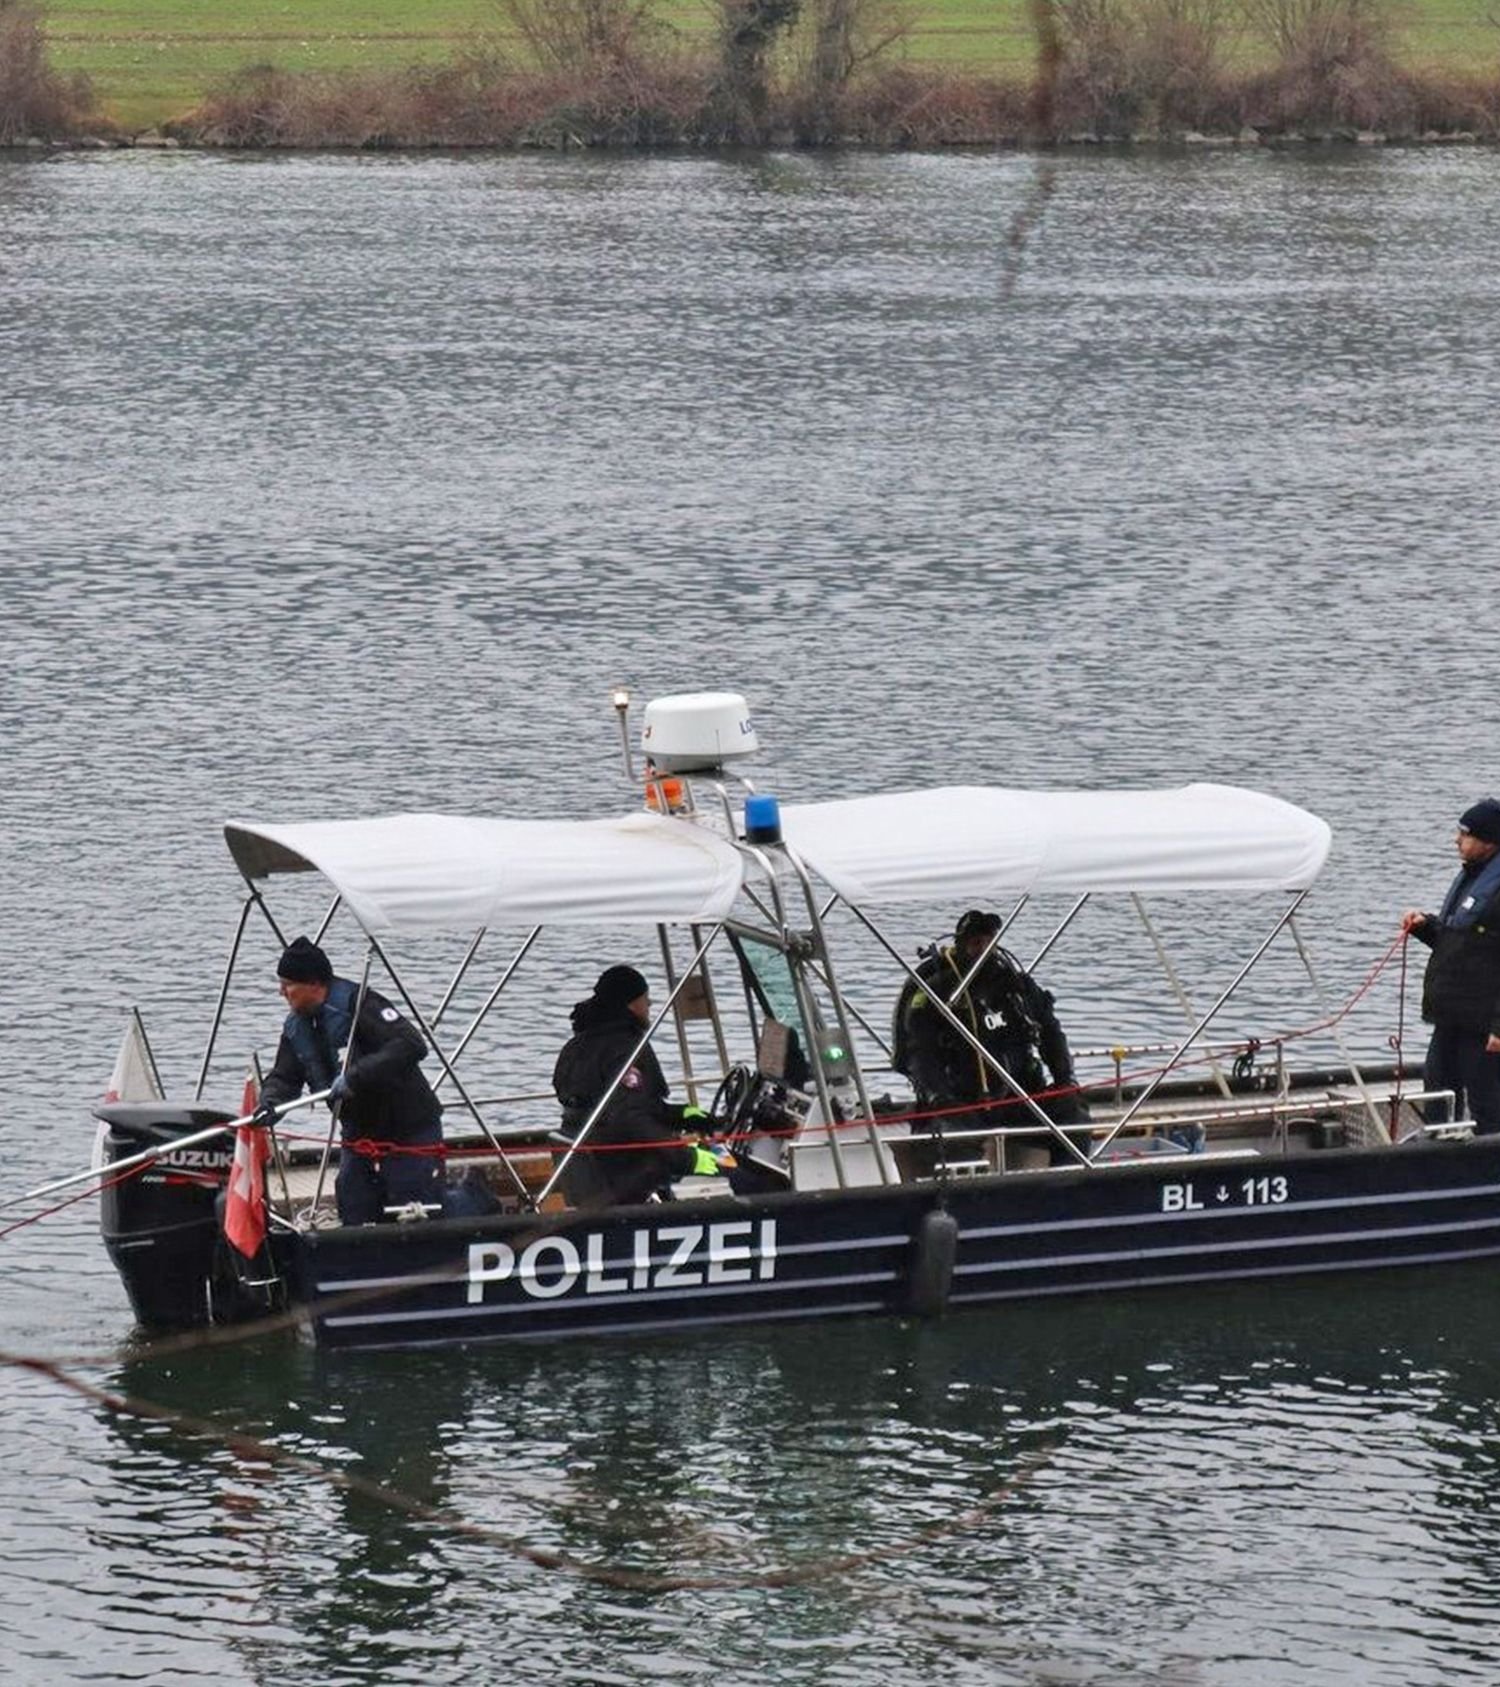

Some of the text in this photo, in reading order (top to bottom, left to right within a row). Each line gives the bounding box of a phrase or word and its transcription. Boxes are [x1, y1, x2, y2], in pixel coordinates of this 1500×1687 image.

[1162, 1176, 1288, 1212] BL 113
[467, 1219, 777, 1304] POLIZEI
